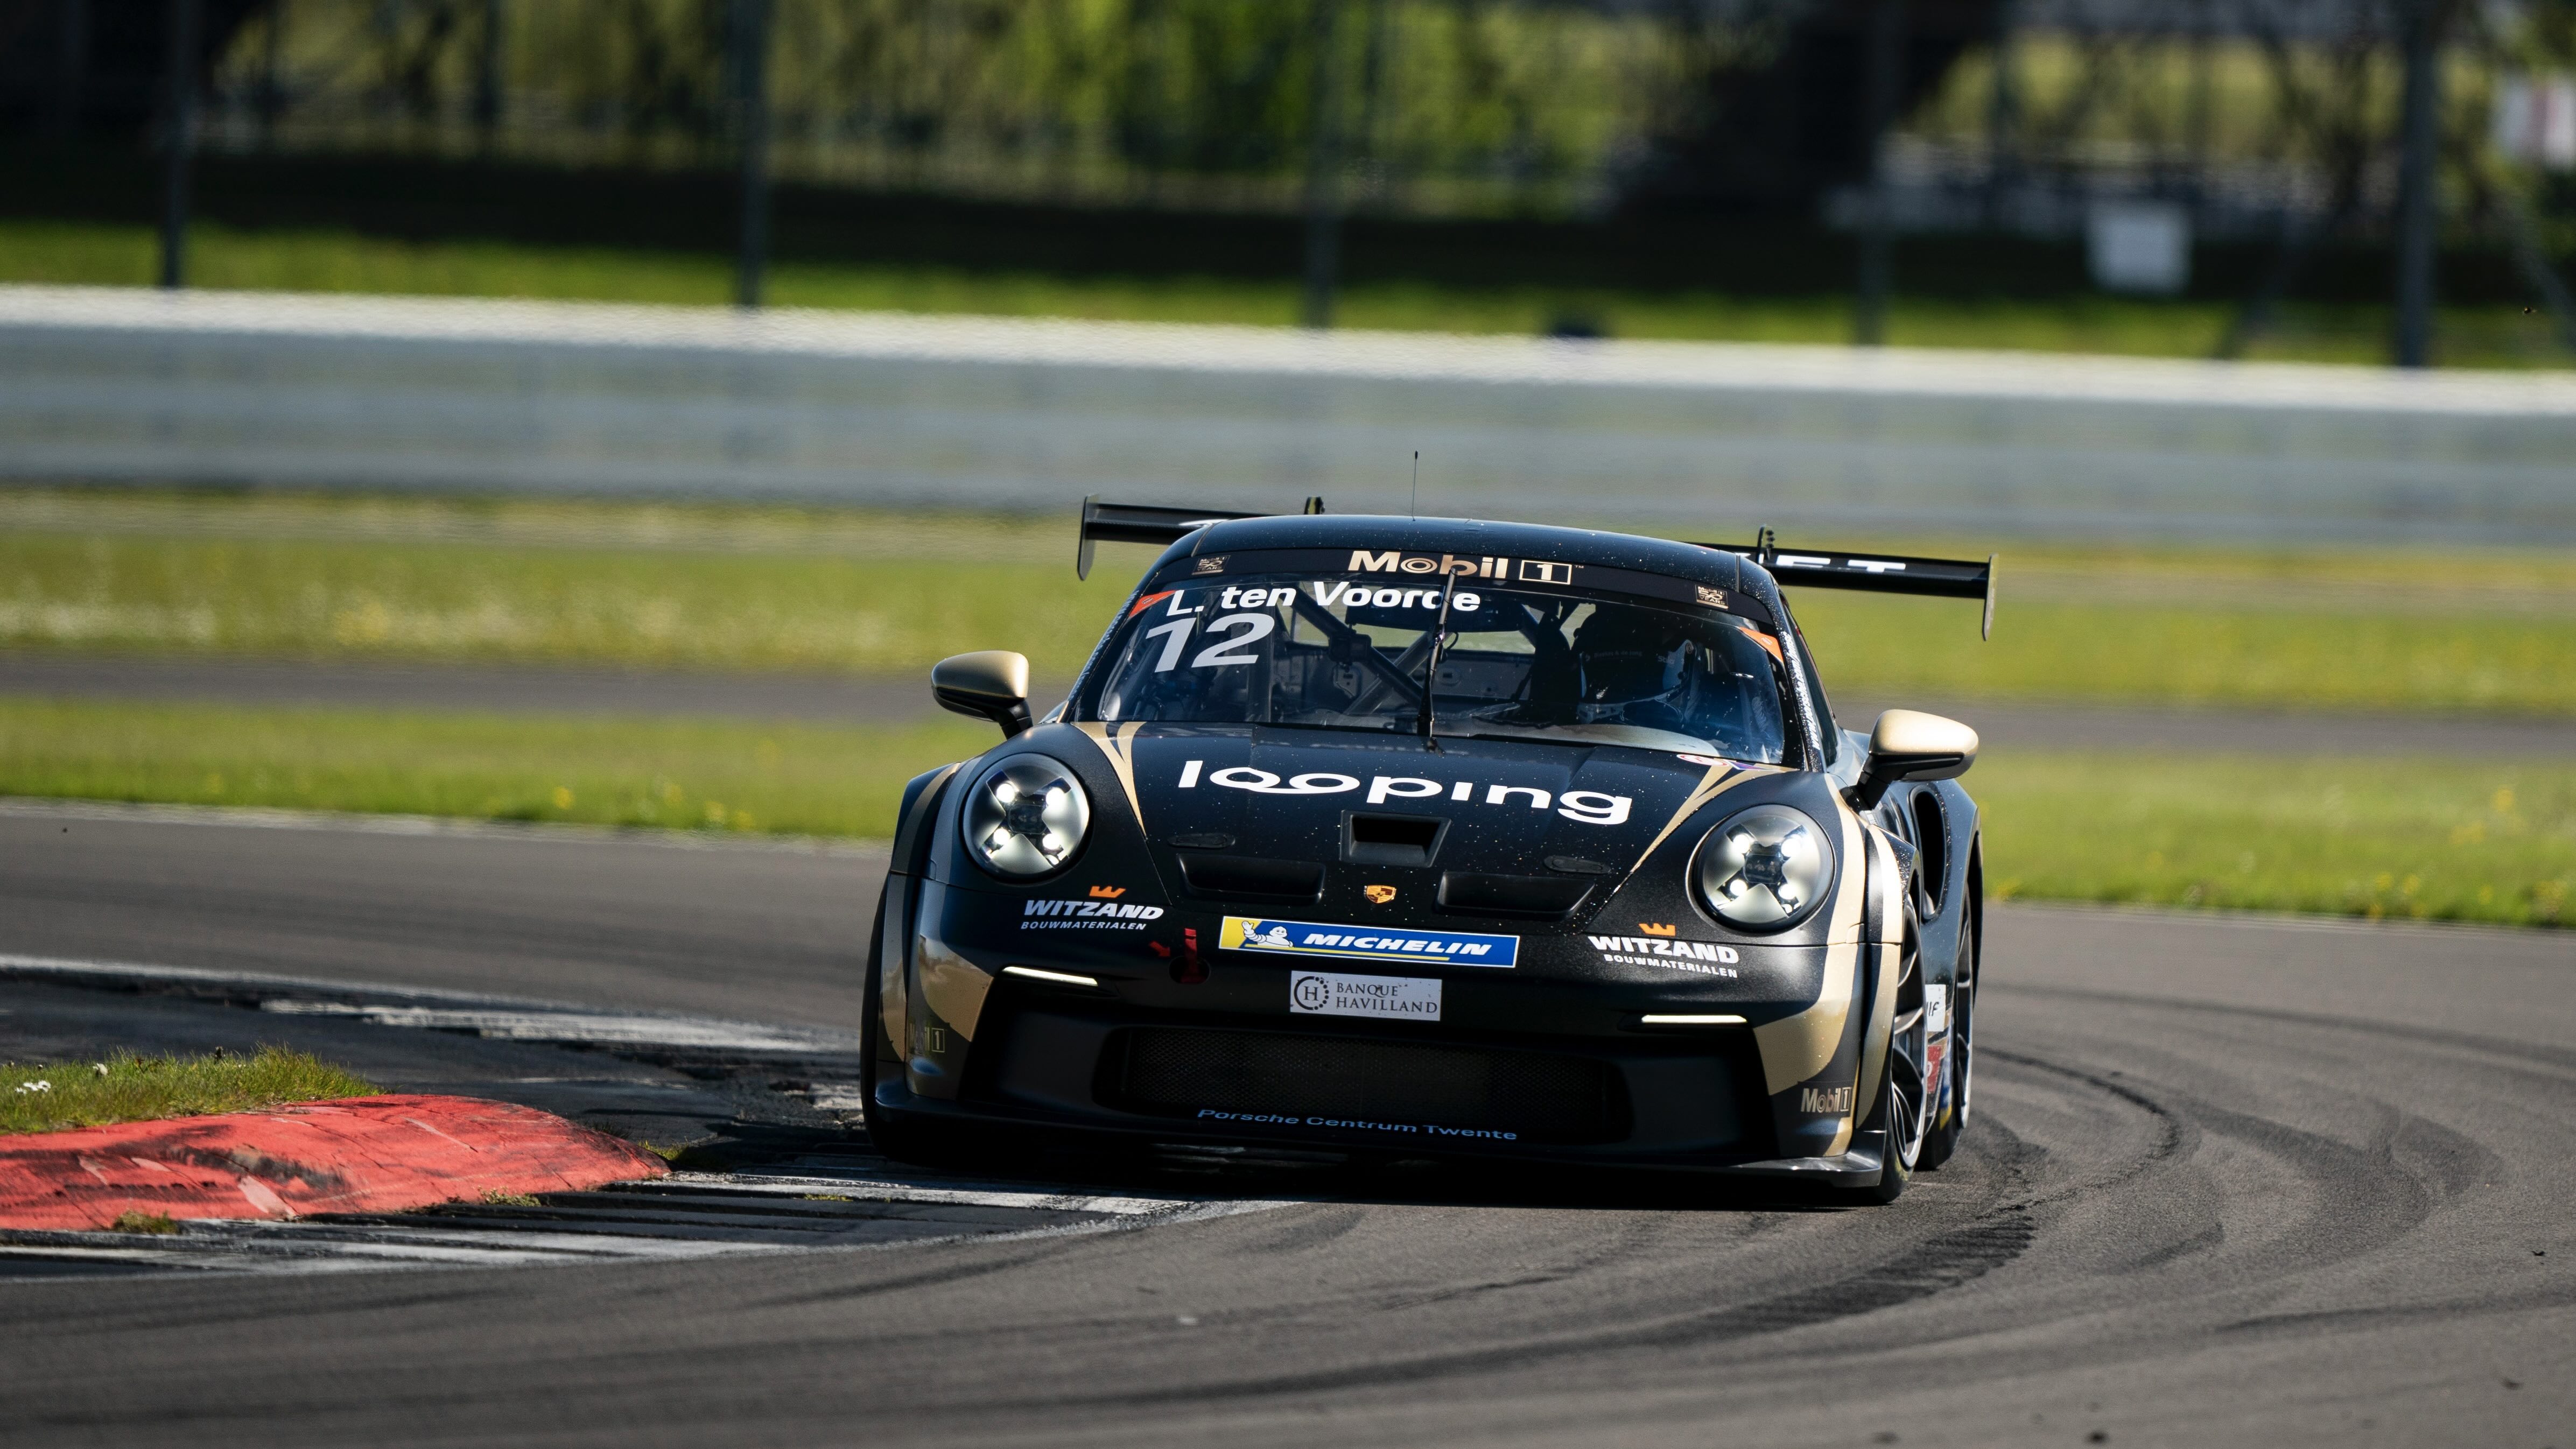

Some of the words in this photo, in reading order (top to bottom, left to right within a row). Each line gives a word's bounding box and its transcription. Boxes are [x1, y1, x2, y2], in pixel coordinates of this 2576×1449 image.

[1347, 551, 1508, 579] Mobil
[1166, 589, 1204, 617] L.
[1221, 586, 1296, 609] ten
[1146, 613, 1275, 673] 12
[1178, 759, 1632, 825] looping
[1024, 899, 1164, 919] WITZAND
[1021, 921, 1146, 931] BOUWMATERIALEN
[1303, 933, 1492, 955] MICHELIN
[1588, 935, 1739, 964] WITZAND
[1603, 954, 1738, 979] BOUWMATERIALEN
[1336, 982, 1399, 998] BANQUE
[1336, 996, 1438, 1014] HAVILLAND
[1800, 1087, 1841, 1113] Mobil
[1197, 1109, 1299, 1125] Porsche
[1306, 1117, 1417, 1133] Centrum
[1423, 1124, 1517, 1140] Twente
